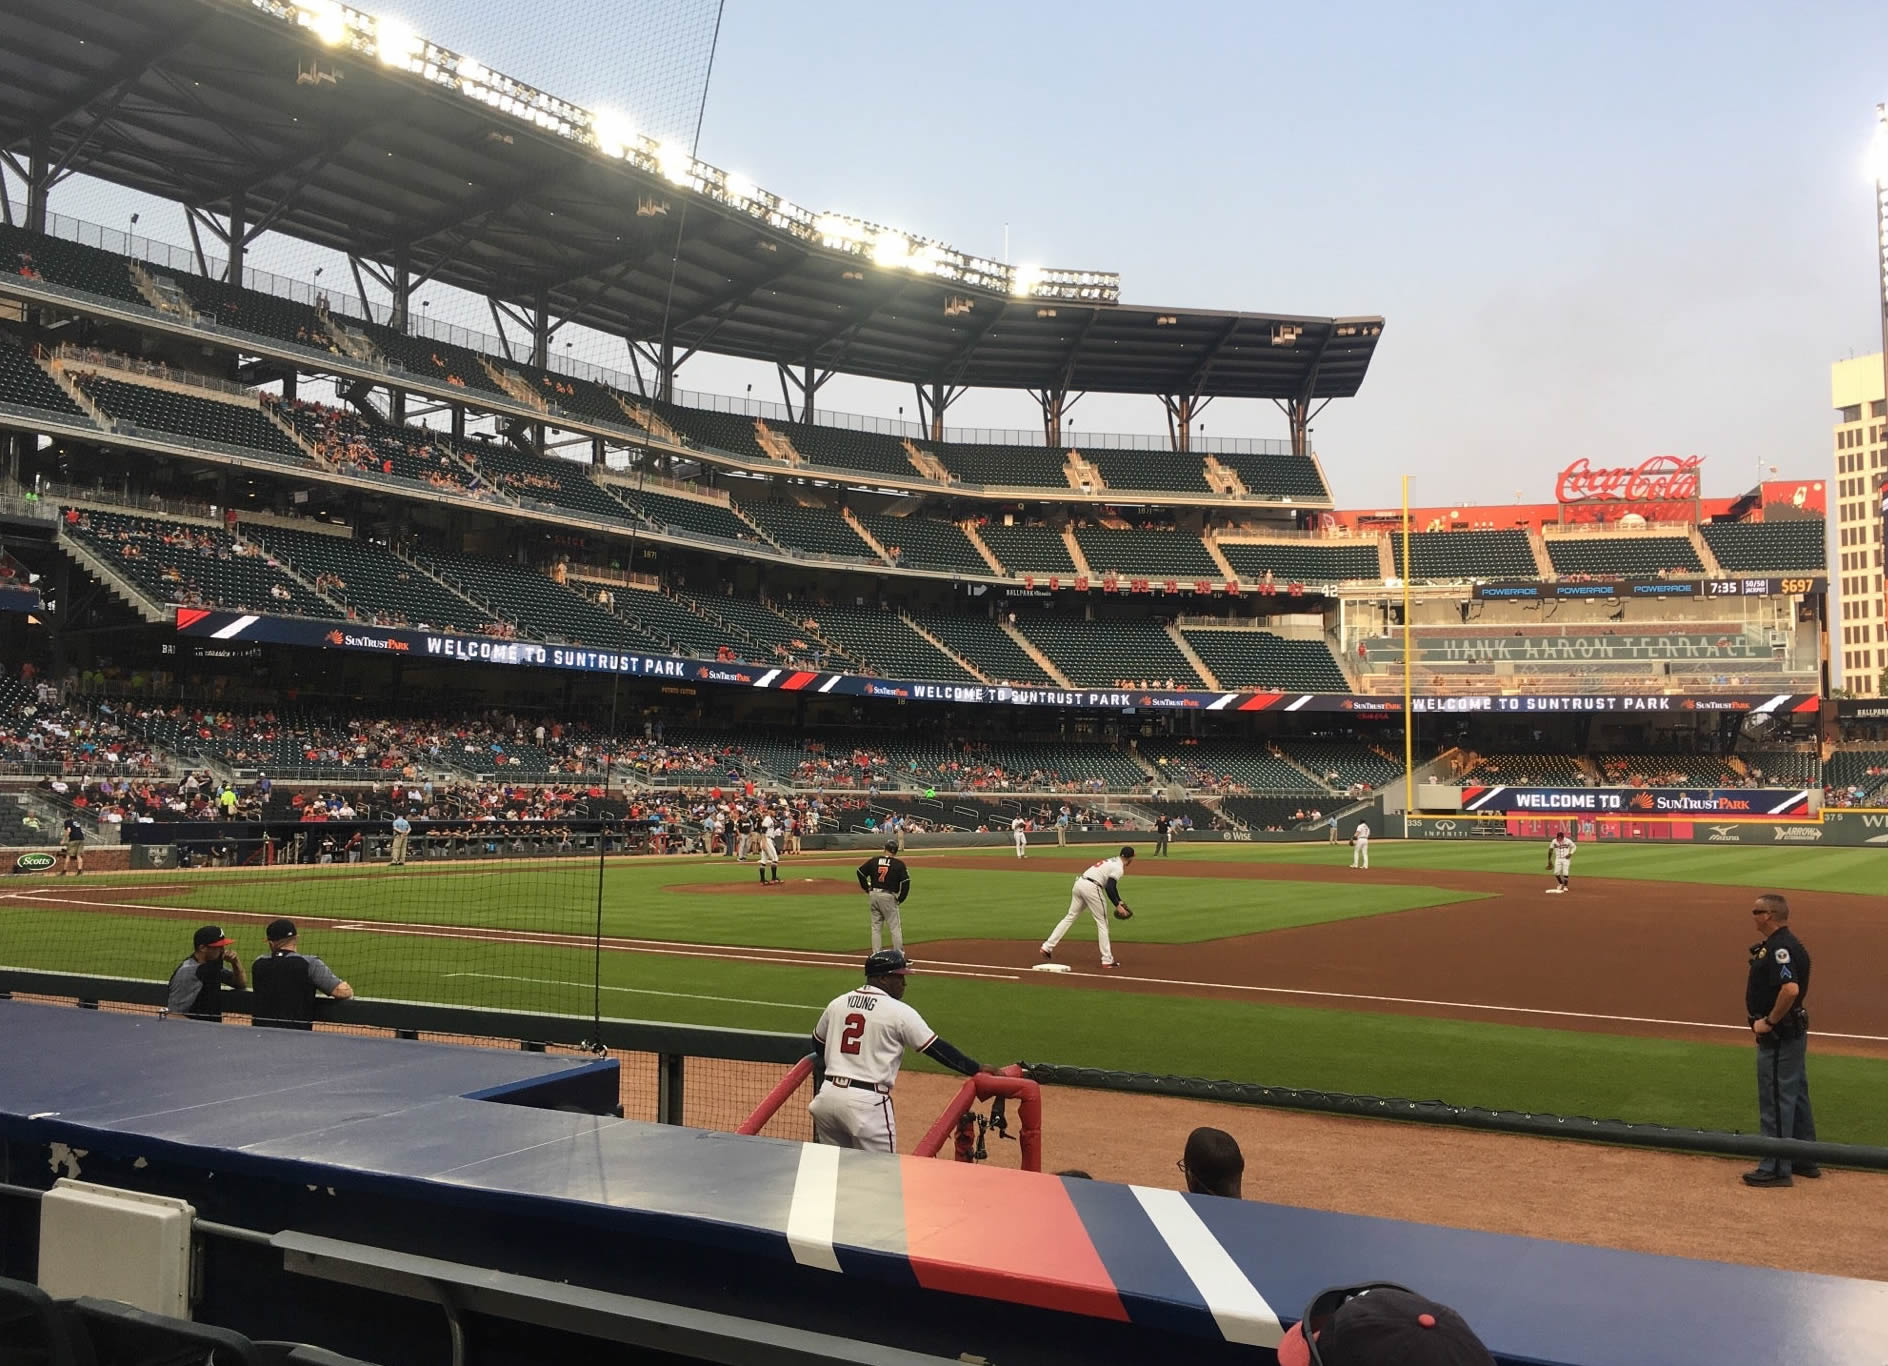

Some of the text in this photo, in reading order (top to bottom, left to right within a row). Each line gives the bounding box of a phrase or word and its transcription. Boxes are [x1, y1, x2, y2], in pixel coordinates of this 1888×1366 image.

[1555, 455, 1706, 503] Coca-Cola
[1103, 577, 1118, 592] 21
[1225, 581, 1240, 596] 41
[1258, 583, 1276, 597] 44
[1321, 584, 1339, 598] 42
[1481, 588, 1538, 596] POWERADE
[1556, 586, 1615, 595] POWERADE
[1633, 584, 1692, 593] POWERADE
[1710, 582, 1737, 594] 7:35
[1781, 578, 1814, 594] $697
[1446, 637, 1756, 660] HANK AARON TERRACE
[427, 637, 685, 677] WELCOME TO SUNTRUST PARK
[913, 685, 1131, 706] WELCOME TO SUNTRUST PARK
[1412, 698, 1670, 711] WELCOME TO SUNTRUST PARK
[1516, 794, 1621, 809] WELCOME TO
[1407, 819, 1422, 827] 335
[1824, 814, 1843, 822] 375
[22, 856, 52, 866] Scotts
[877, 866, 889, 883] 7
[847, 995, 878, 1011] YOUNG
[840, 1012, 866, 1055] 2
